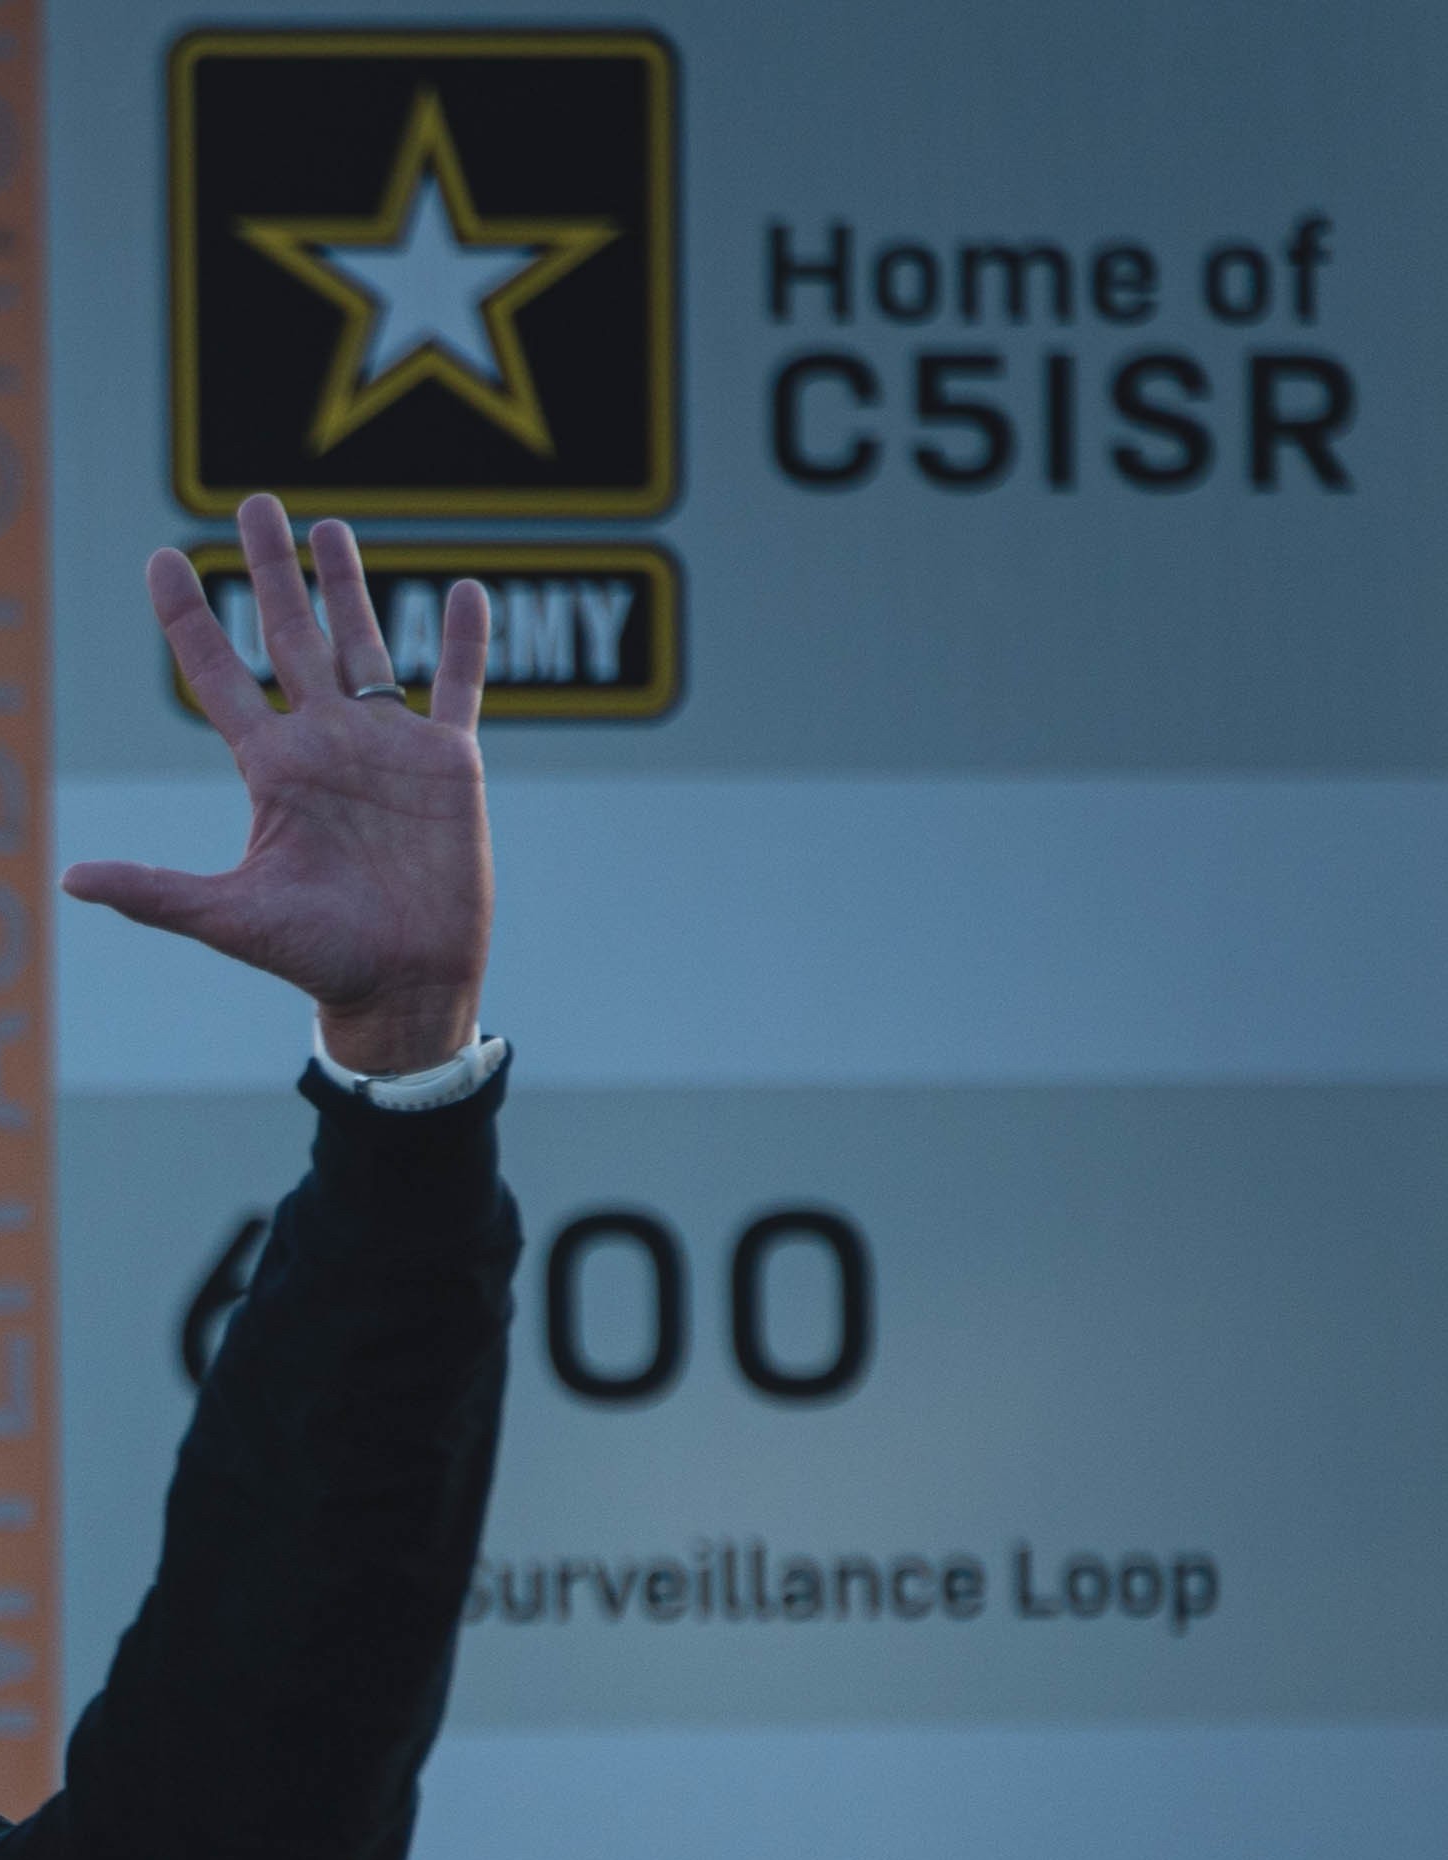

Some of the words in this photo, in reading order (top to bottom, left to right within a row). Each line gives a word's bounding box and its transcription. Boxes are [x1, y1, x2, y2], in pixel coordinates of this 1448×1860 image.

[768, 218, 1158, 326] Home
[1203, 211, 1333, 326] of
[770, 346, 1360, 495] C5ISR
[1018, 1541, 1220, 1637] Loop
